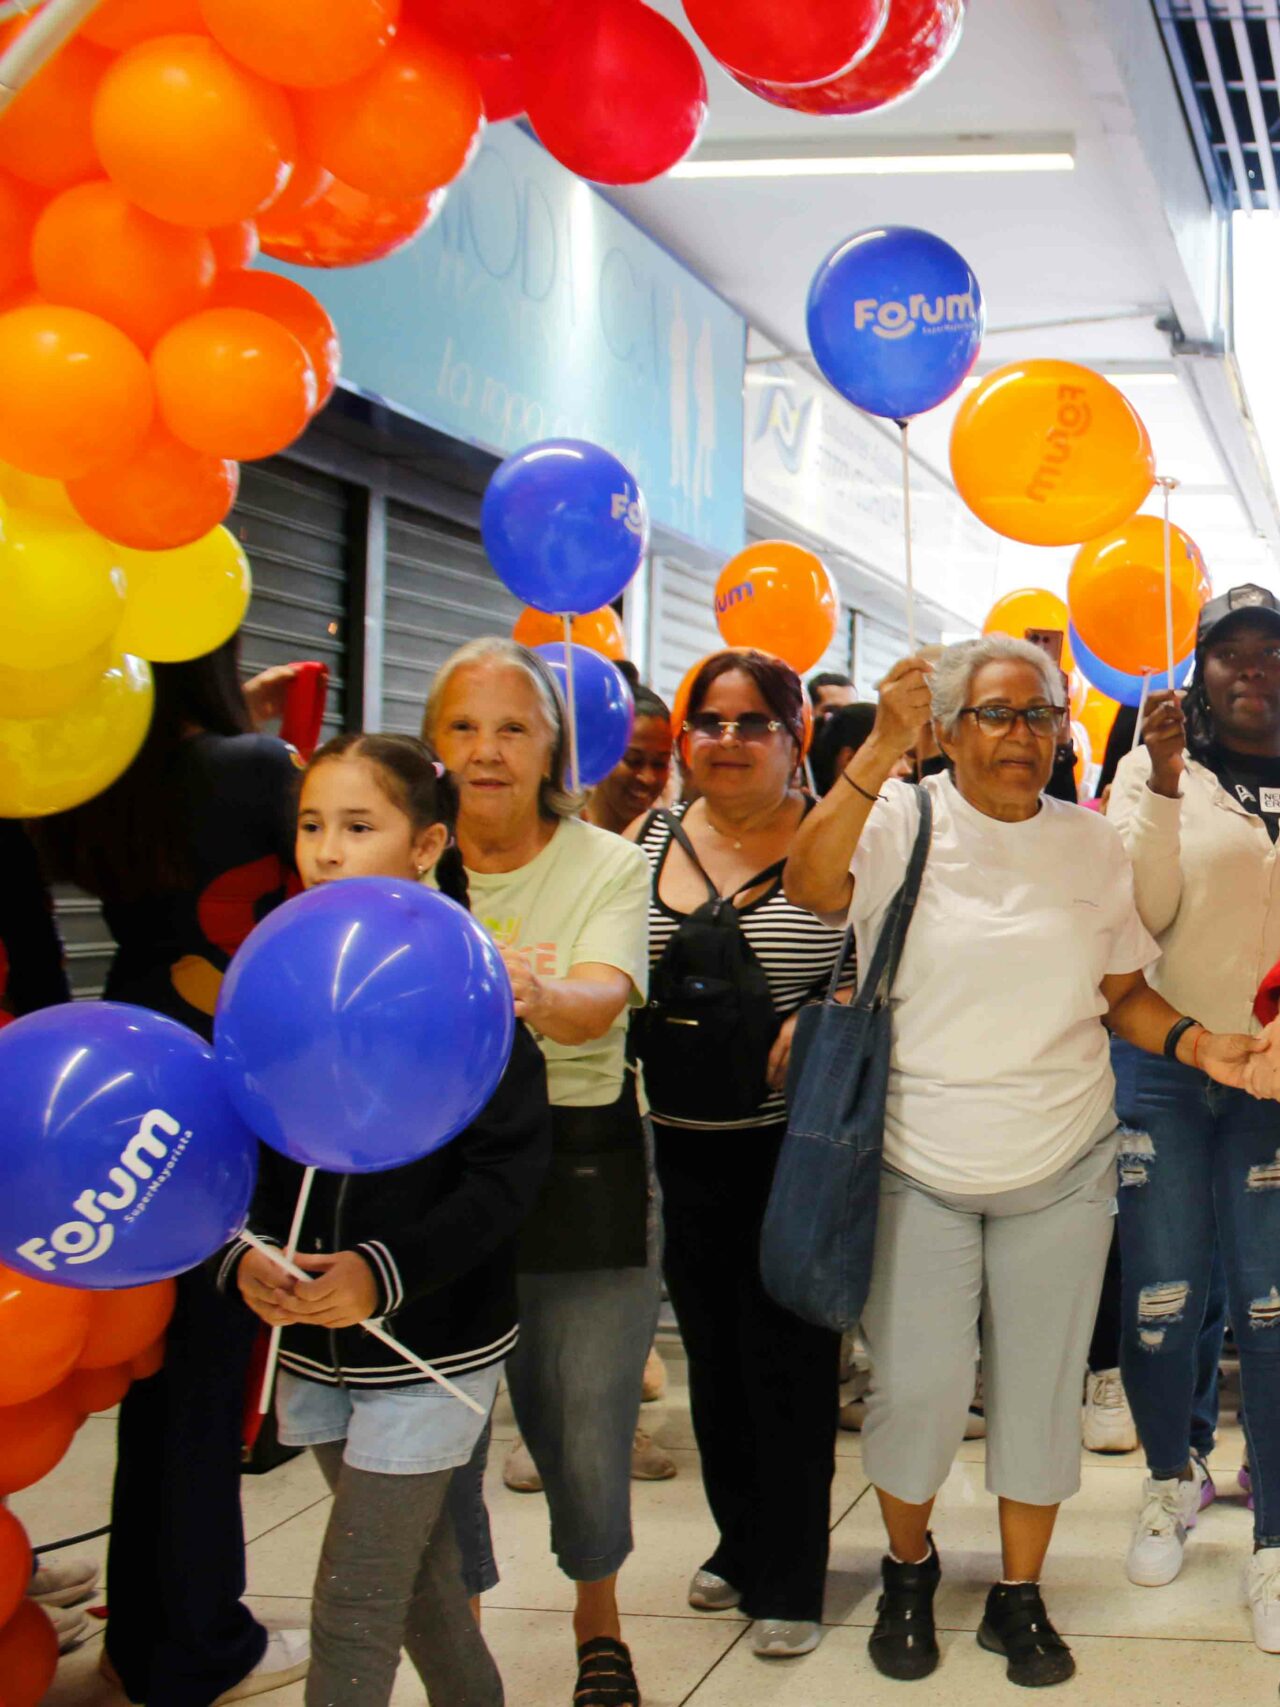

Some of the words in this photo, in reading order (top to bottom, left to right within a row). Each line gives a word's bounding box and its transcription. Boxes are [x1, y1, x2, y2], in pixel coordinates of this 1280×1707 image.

[854, 294, 974, 339] Forum
[16, 1109, 181, 1271] Forum
[124, 1130, 193, 1223] SuperMayorista
